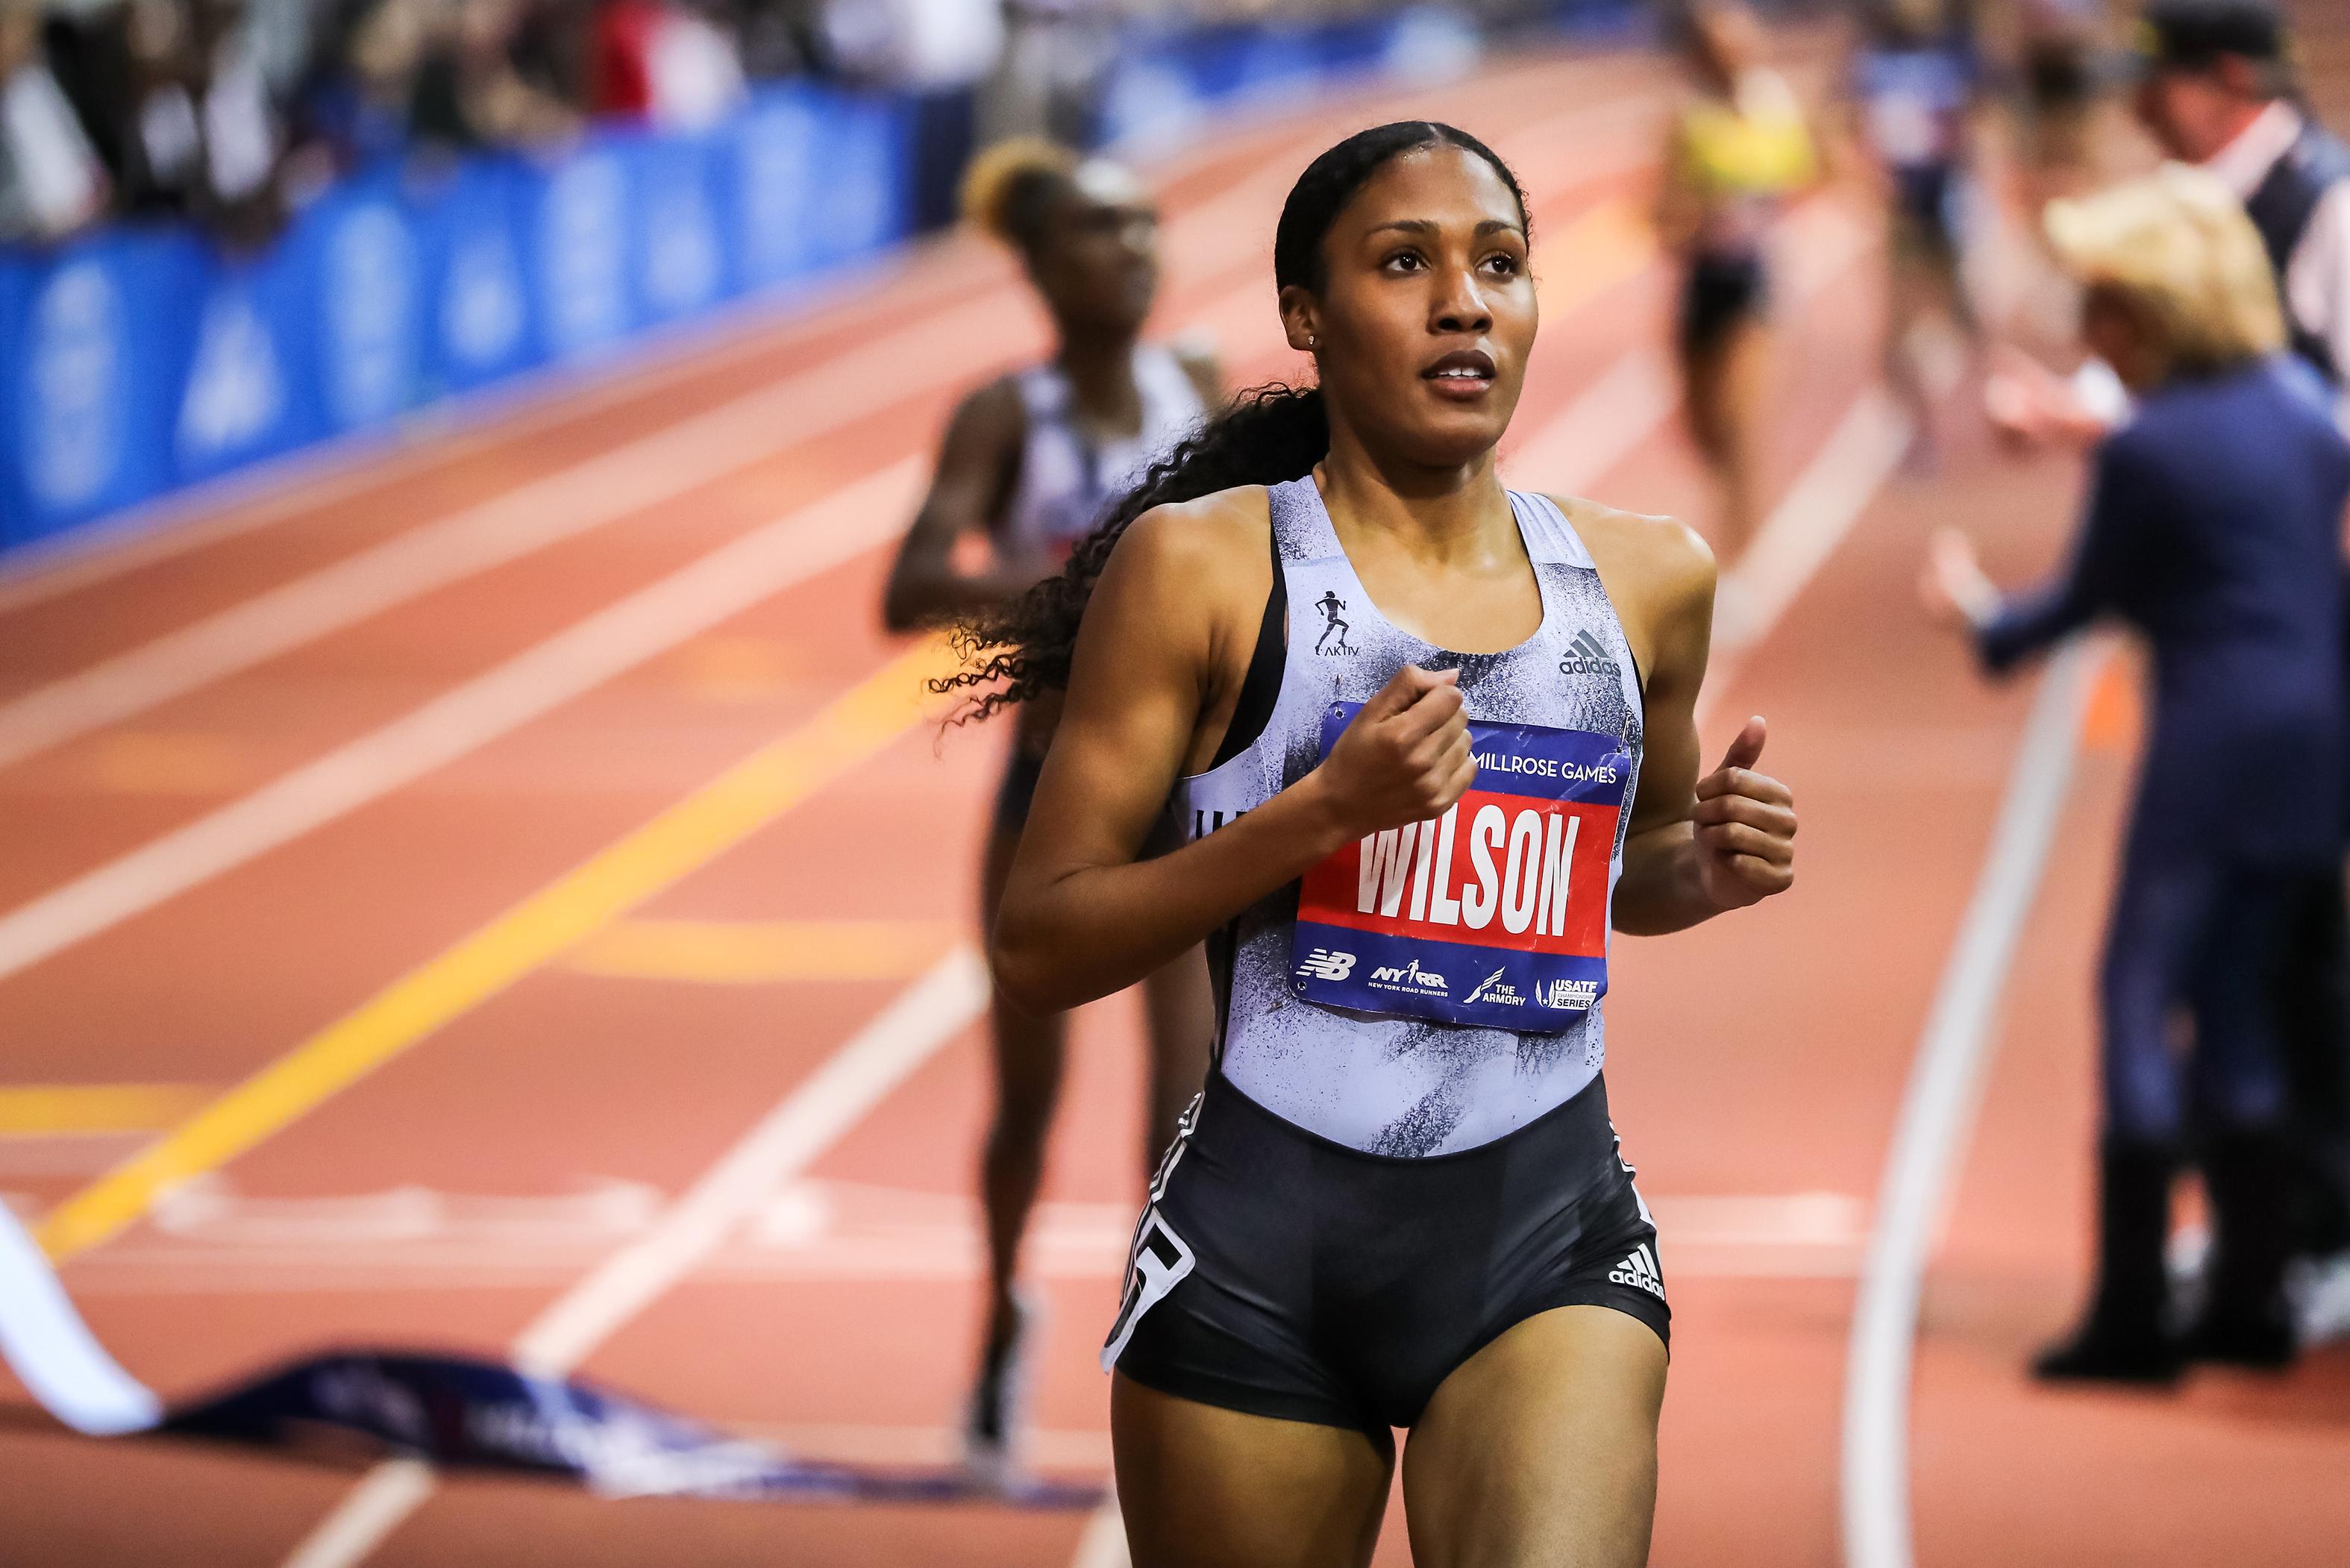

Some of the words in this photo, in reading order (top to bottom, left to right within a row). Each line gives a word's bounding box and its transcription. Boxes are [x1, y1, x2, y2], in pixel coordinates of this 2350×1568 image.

[1559, 656, 1622, 677] adidas
[1469, 750, 1558, 777] MILLROSE
[1561, 762, 1617, 784] GAMES
[1357, 802, 1581, 937] WILSON
[1420, 988, 1448, 997] RUNNERS
[1495, 984, 1516, 995] THE
[1555, 979, 1599, 993] USATF
[1482, 992, 1526, 1006] ARMORY
[1557, 998, 1591, 1008] SERIES
[1608, 1270, 1665, 1301] adidas
